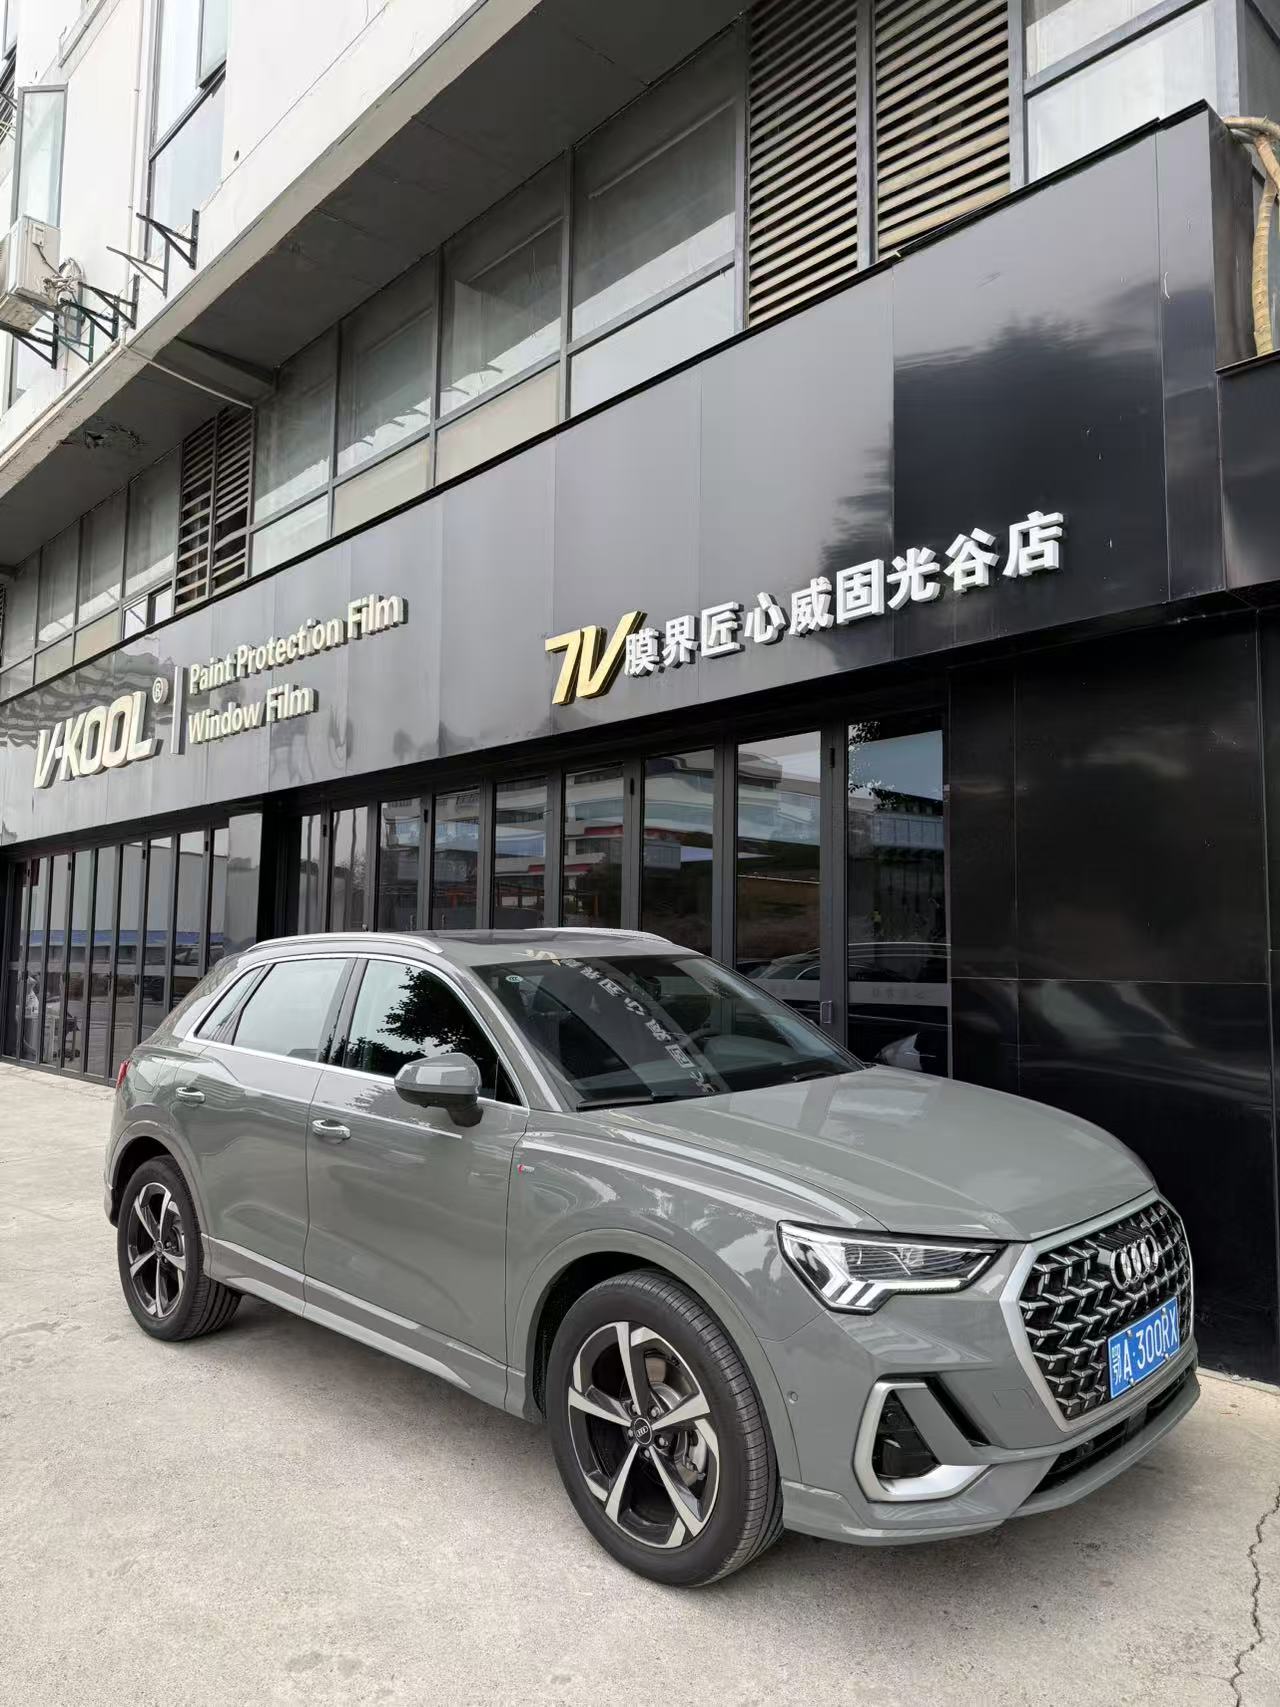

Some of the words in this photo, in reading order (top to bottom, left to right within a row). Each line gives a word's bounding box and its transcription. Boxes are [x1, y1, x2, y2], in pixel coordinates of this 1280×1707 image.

[188, 652, 236, 695] Paint
[236, 617, 348, 678] Protection
[347, 593, 408, 639] Film
[624, 510, 1064, 678] 膜界匠心威固光谷店
[188, 700, 266, 744] Window
[265, 683, 318, 724] Film
